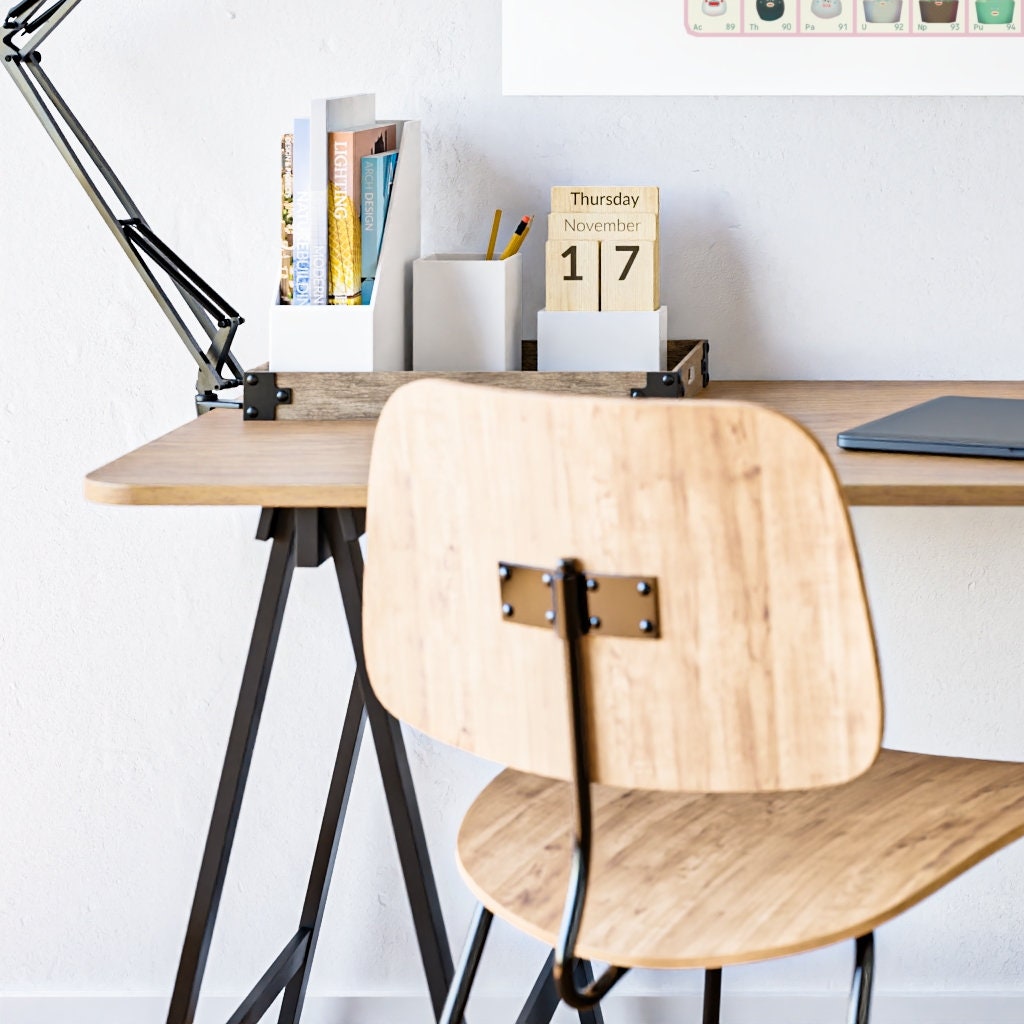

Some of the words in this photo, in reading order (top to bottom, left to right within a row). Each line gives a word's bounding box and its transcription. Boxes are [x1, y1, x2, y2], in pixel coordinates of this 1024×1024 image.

[334, 141, 348, 220] LIGHTING
[364, 161, 374, 190] ARCH
[364, 192, 374, 231] DESIGN
[570, 191, 640, 208] Thursday
[564, 218, 642, 232] November
[313, 246, 325, 304] MODERN
